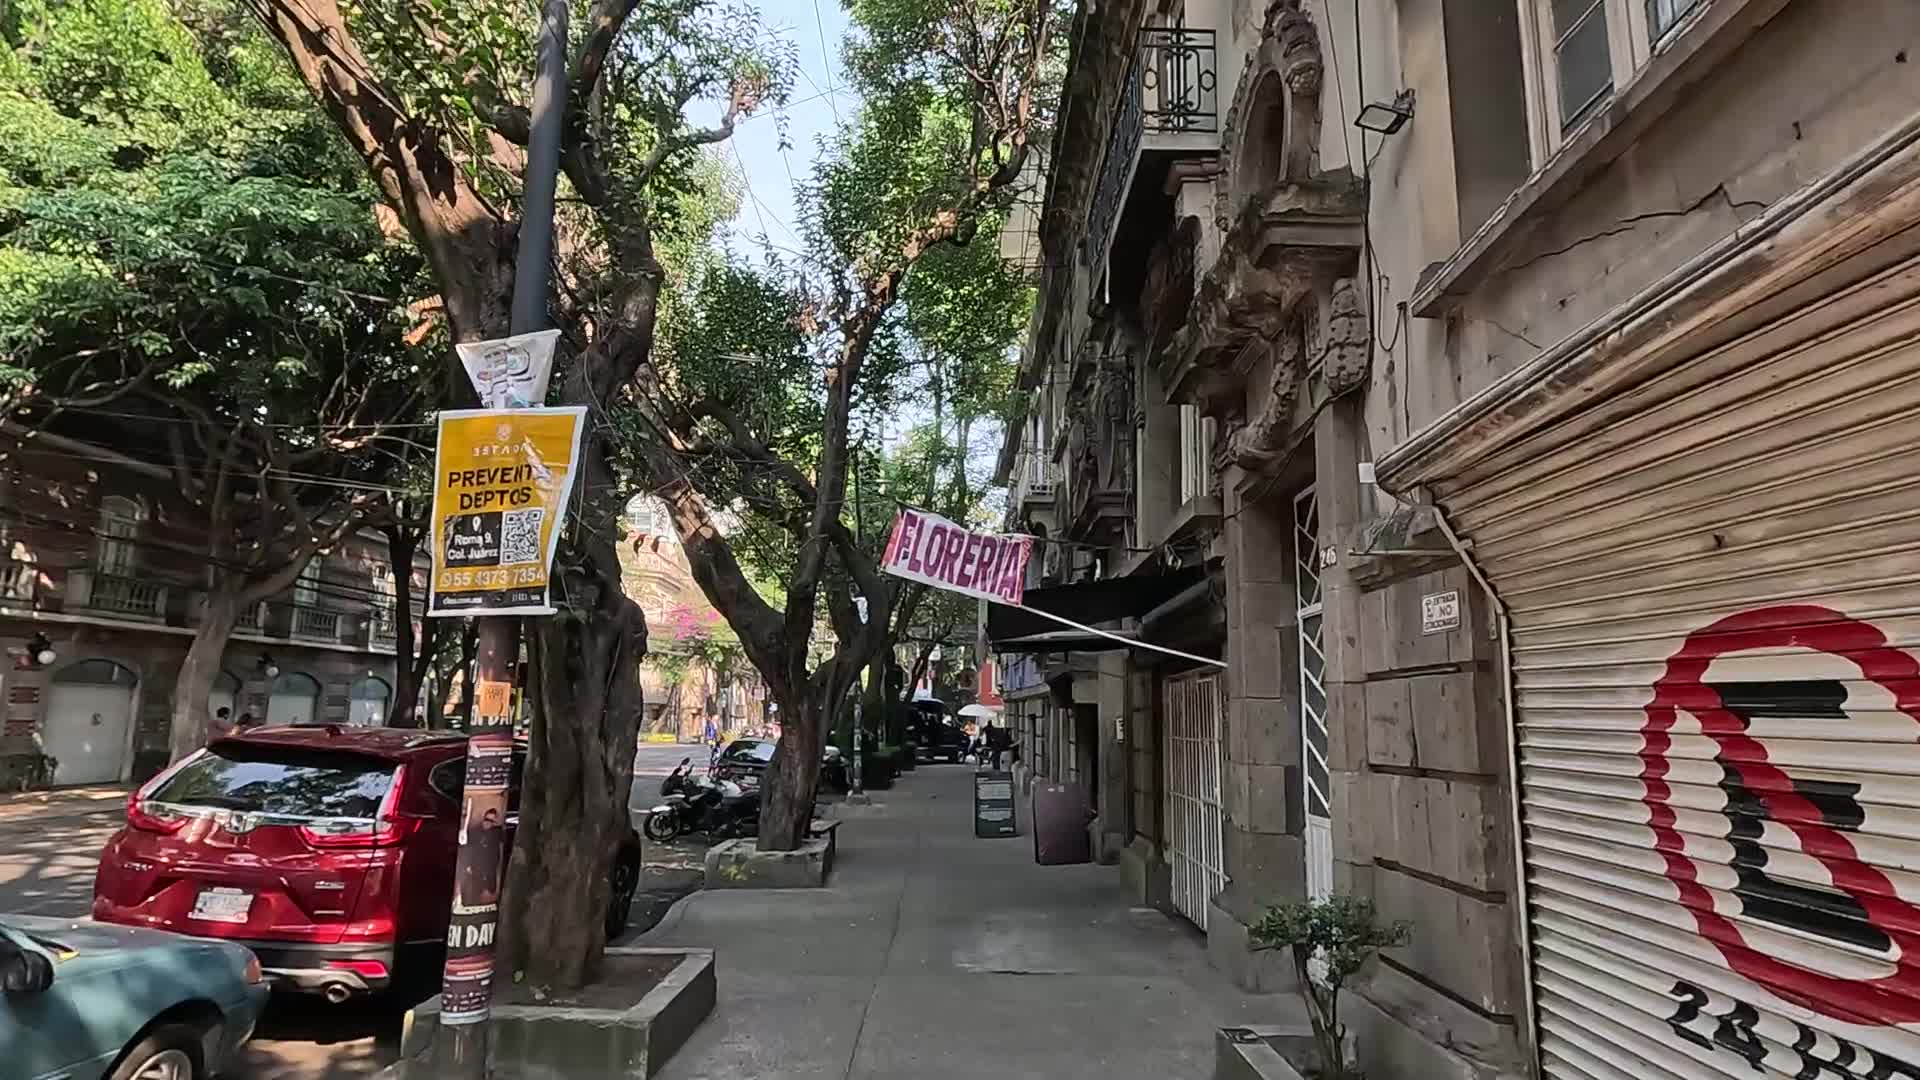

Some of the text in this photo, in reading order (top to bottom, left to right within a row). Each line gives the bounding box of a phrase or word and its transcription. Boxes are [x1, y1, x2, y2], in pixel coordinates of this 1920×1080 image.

[448, 464, 533, 488] PREVENT
[460, 487, 532, 510] DEPTOS
[893, 512, 1021, 599] FLORERIA
[512, 567, 546, 585] 7354
[1439, 604, 1453, 617] NO
[465, 921, 497, 948] DAY
